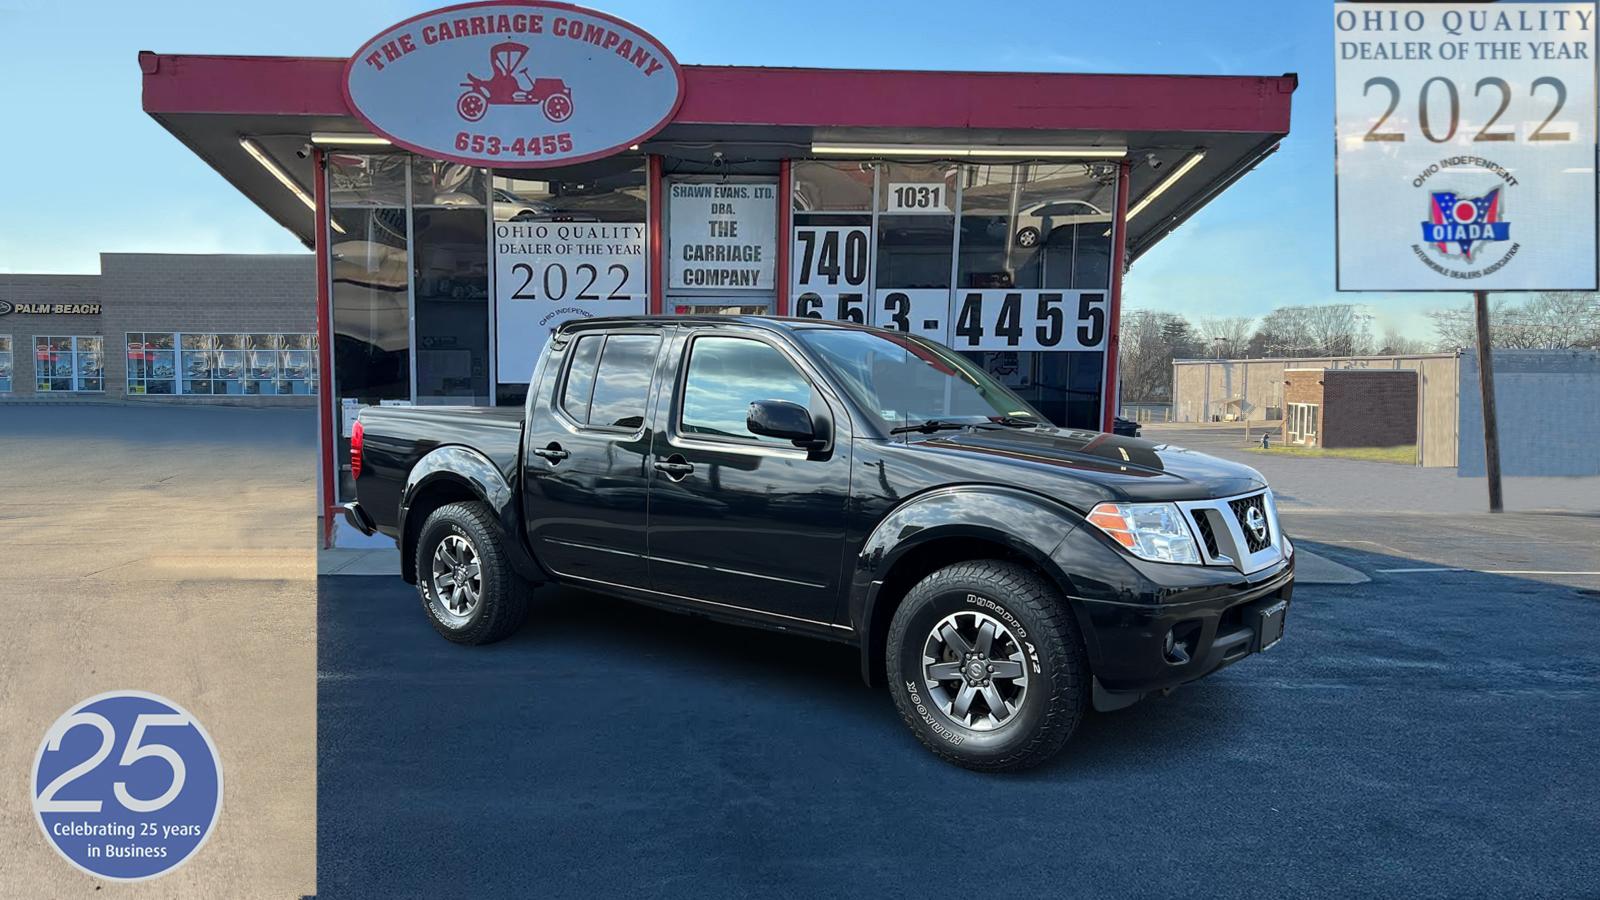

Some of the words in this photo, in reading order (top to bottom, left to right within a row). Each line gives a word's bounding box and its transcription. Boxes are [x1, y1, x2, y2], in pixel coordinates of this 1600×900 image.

[1336, 10, 1425, 31] OHIO
[1442, 10, 1592, 35] QUALITY
[365, 33, 417, 72] THE
[422, 14, 543, 46] CARRIAGE
[553, 16, 664, 78] COMPANY
[1340, 41, 1433, 60] DEALER
[1439, 41, 1469, 60] OF
[1475, 41, 1522, 60] THE
[1528, 41, 1589, 60] YEAR
[1363, 76, 1571, 143] 2022
[455, 132, 573, 157] 653-4455
[1412, 163, 1440, 188] OHIO
[1440, 155, 1520, 187] INDEPENDENT
[673, 185, 712, 198] SHAWN
[754, 187, 775, 199] LTD.
[894, 186, 941, 208] 1031
[711, 203, 736, 215] DBA.
[497, 225, 548, 239] OHIO
[557, 226, 644, 240] QUALITY
[708, 220, 738, 238] THE
[1432, 224, 1495, 241] OIADA
[500, 243, 552, 255] DEALER
[555, 243, 573, 255] OF
[576, 243, 602, 255] THE
[607, 244, 641, 255] YEAR
[683, 244, 762, 262] CARRIAGE
[797, 230, 868, 286] 740
[1411, 244, 1451, 277] AUTOMOBILE
[1450, 271, 1482, 280] DEALERS
[1483, 242, 1521, 276] ASSOCIATION
[511, 263, 631, 301] 2022
[683, 268, 760, 286] COMPANY
[14, 303, 51, 314] PALM
[54, 303, 101, 315] BEACH
[1024, 641, 1042, 675] AT2
